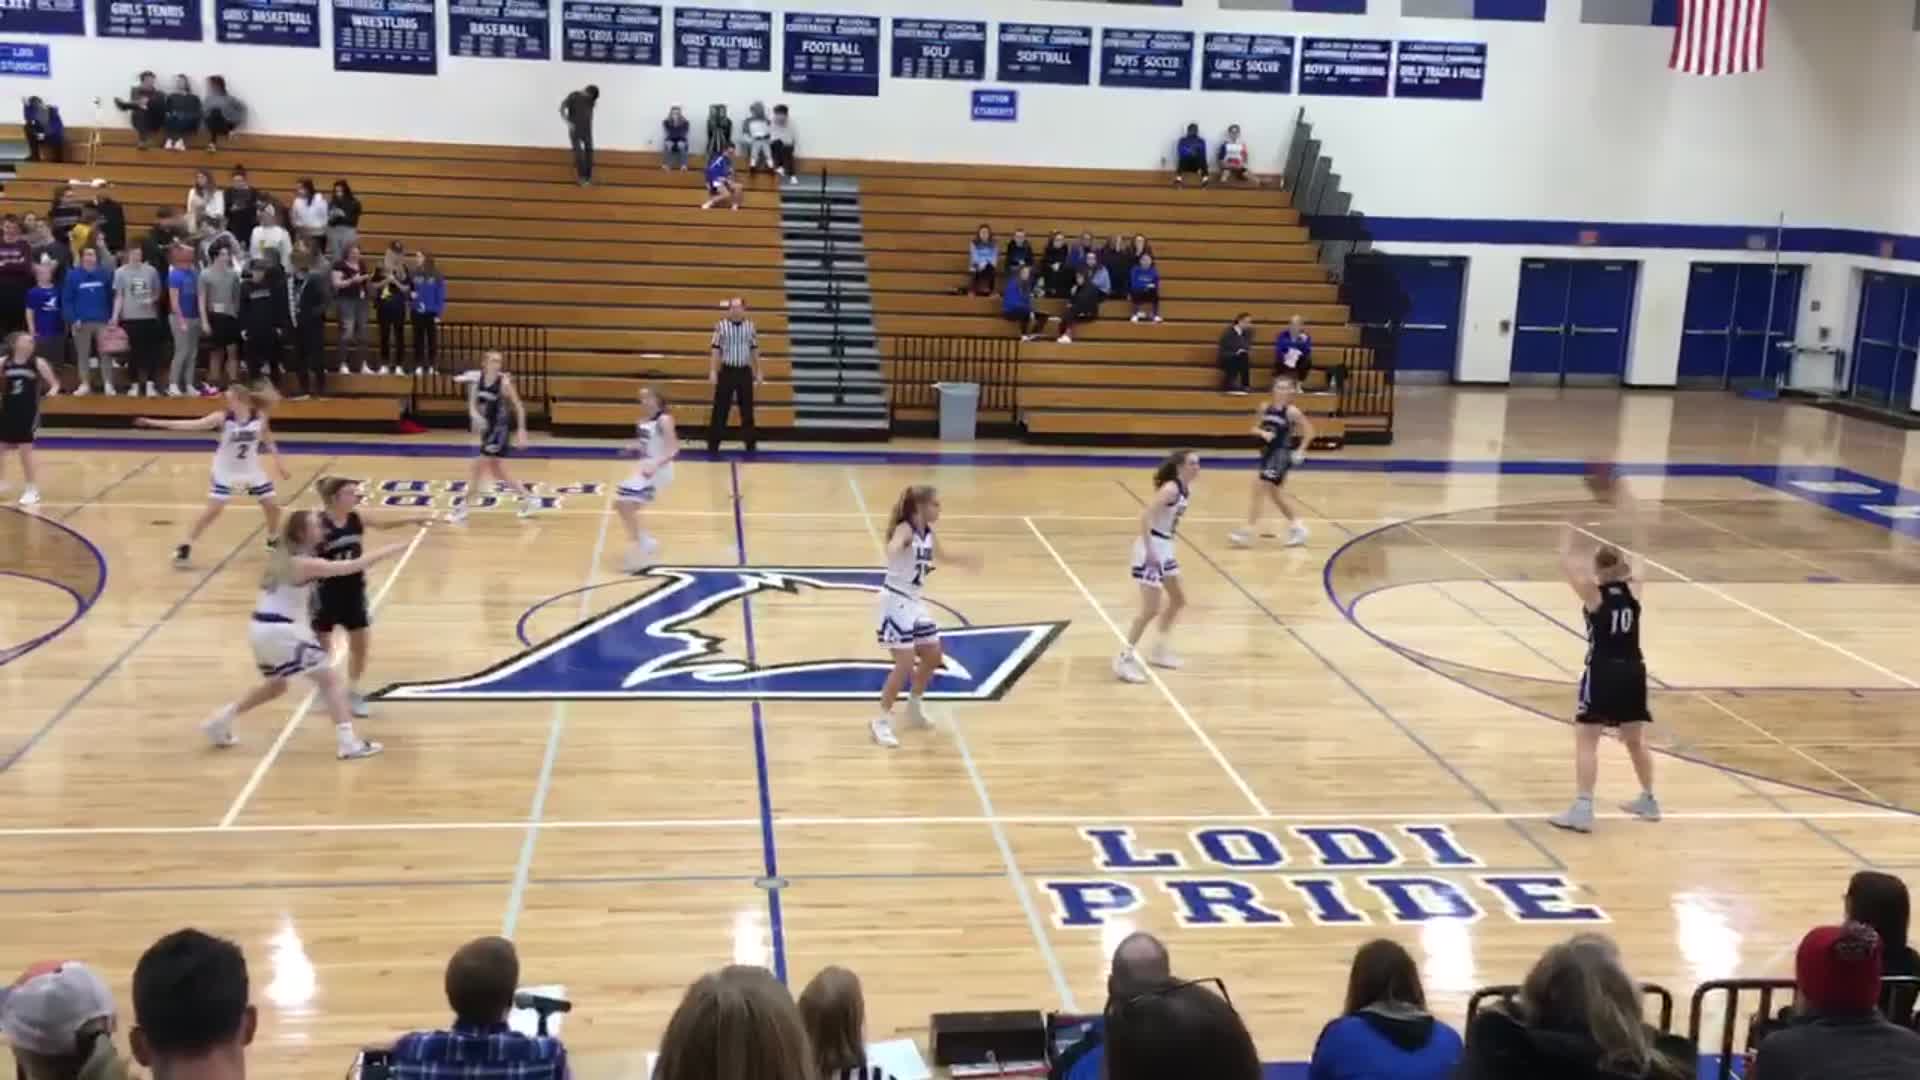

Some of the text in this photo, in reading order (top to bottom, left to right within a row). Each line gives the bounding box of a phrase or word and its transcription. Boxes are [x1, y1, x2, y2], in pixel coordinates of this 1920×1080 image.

[252, 9, 312, 25] BASKETBALL
[351, 14, 419, 30] WRESTLING
[468, 22, 529, 37] BASEBALL
[615, 30, 655, 44] COUNTRY
[709, 35, 763, 49] VOLLEYBALL
[801, 40, 861, 55] FOOTBALL
[921, 45, 952, 58] GOLF
[1016, 50, 1073, 65] SOFTBALL
[1143, 55, 1181, 69] SOCCER
[1246, 60, 1281, 73] SOCCER
[236, 443, 248, 460] 2
[1611, 608, 1633, 634] 10
[1081, 825, 1482, 870] LODI
[1040, 875, 1610, 929] PRIDE
